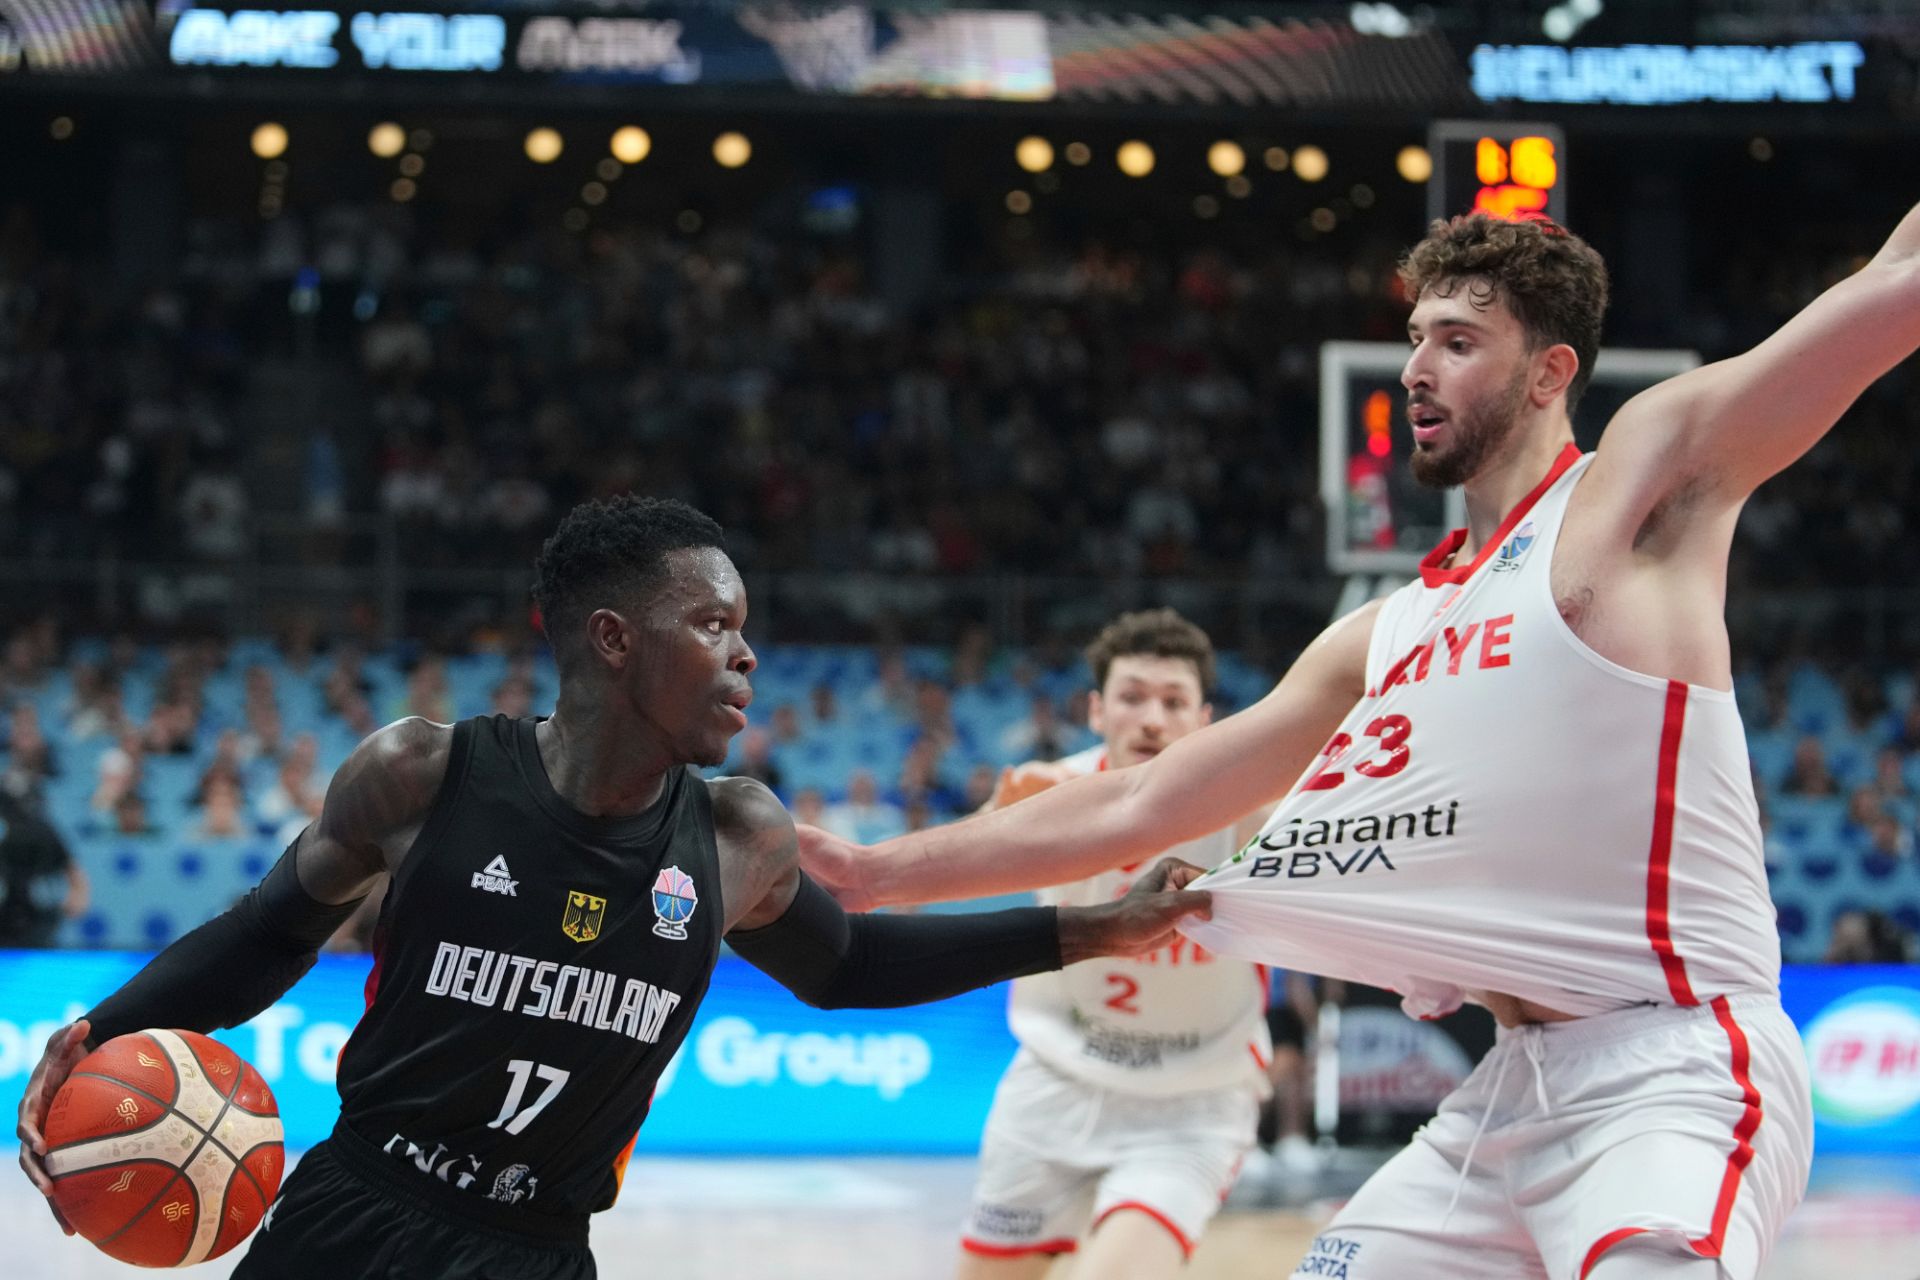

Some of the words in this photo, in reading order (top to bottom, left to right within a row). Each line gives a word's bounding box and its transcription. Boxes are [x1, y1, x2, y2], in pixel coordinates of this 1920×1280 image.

[351, 12, 506, 70] YOUR
[1298, 714, 1412, 794] 23
[1259, 800, 1459, 851] Garanti
[471, 871, 520, 896] PEAK
[1249, 845, 1396, 879] BBVA
[1104, 973, 1140, 1015] 2
[696, 1016, 931, 1101] Group
[487, 1059, 571, 1135] 17
